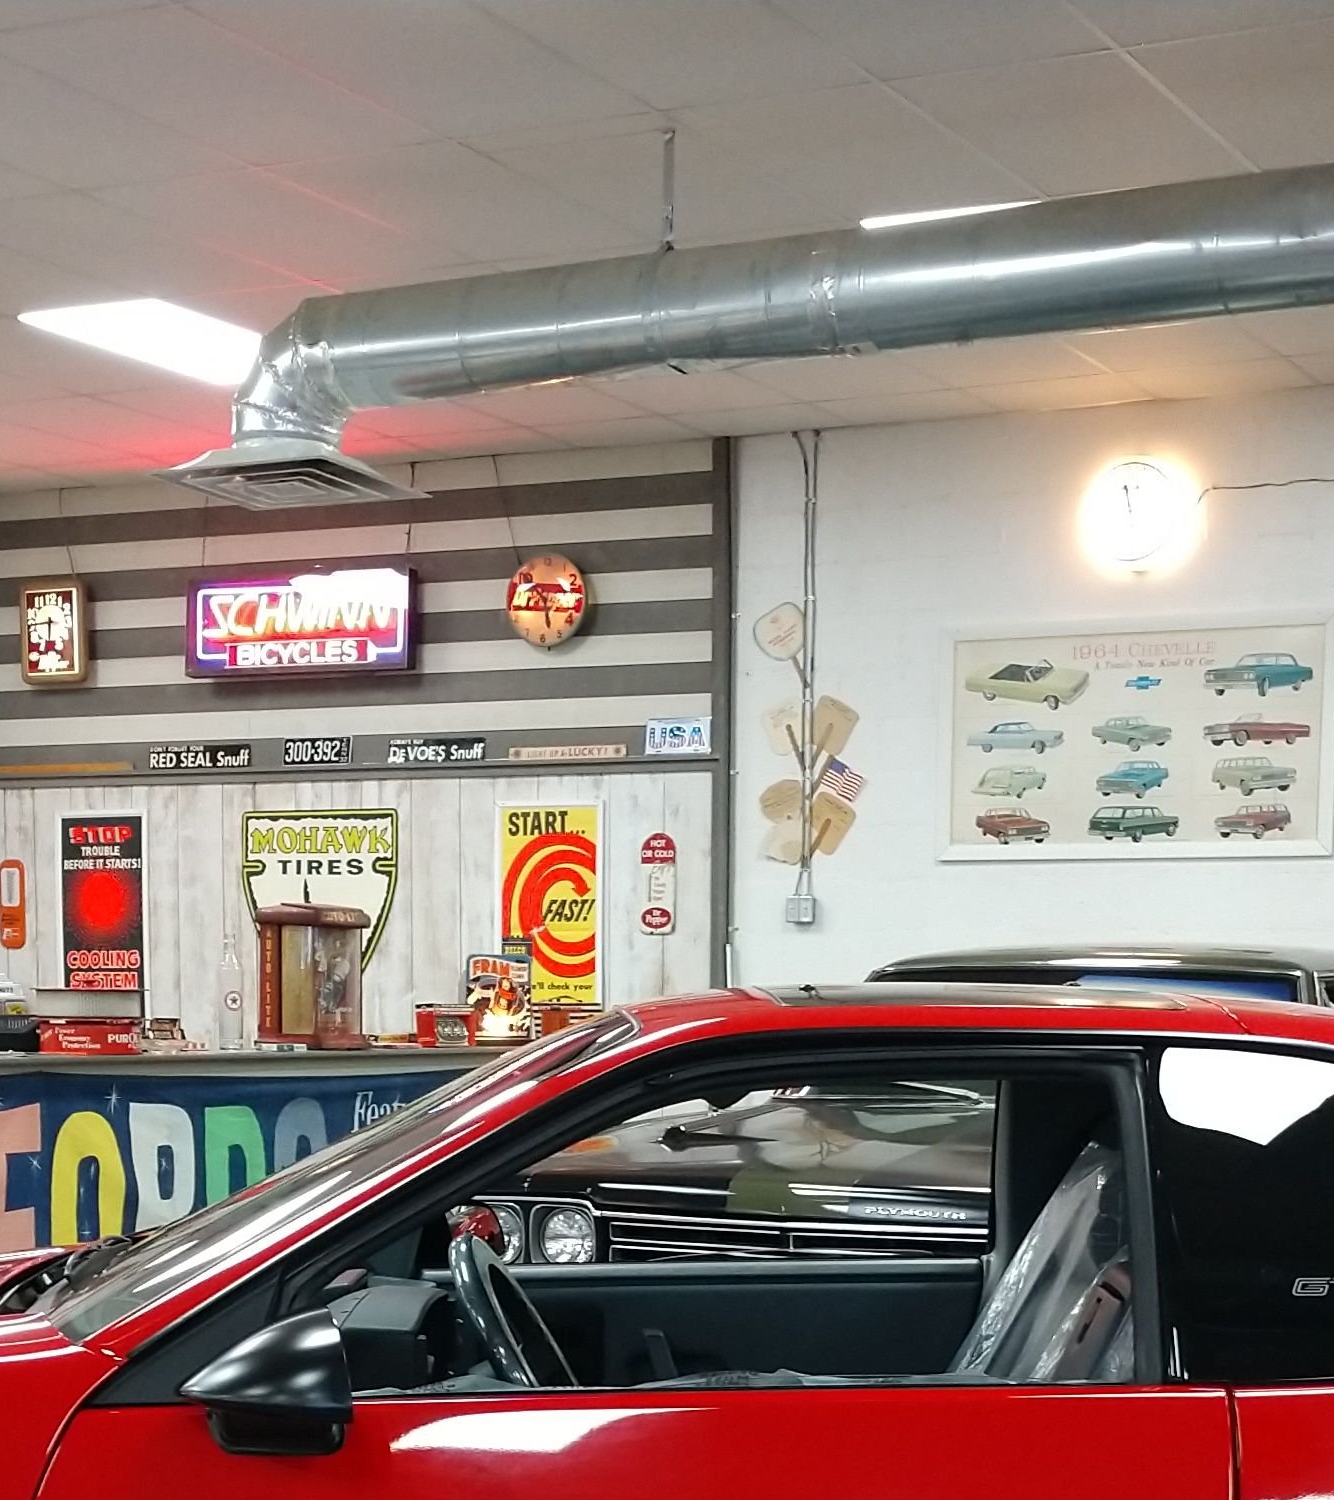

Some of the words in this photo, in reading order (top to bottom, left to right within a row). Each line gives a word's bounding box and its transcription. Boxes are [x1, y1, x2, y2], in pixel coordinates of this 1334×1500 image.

[236, 640, 359, 666] BICYCLES
[1072, 643, 1119, 660] 1964
[1128, 640, 1216, 658] CHEVELLE
[649, 725, 706, 749] USA
[149, 752, 177, 768] RED
[180, 751, 213, 768] SEAL
[216, 749, 250, 767] Snuff
[449, 742, 485, 761] Snuff
[68, 825, 133, 845] STOP
[249, 825, 391, 855] MOHAWK
[650, 839, 667, 848] HOT
[80, 845, 121, 857] TROUBLE
[642, 850, 653, 858] OR
[654, 850, 674, 858] COLD
[63, 859, 95, 871] BEFORE
[96, 859, 104, 869] IT
[105, 858, 142, 869] STARTS!
[277, 858, 364, 876] TIRES
[543, 898, 596, 922] FAST!
[67, 949, 141, 969] COOLING
[472, 957, 511, 978] FRAM
[69, 971, 139, 990] SYSTEM
[547, 982, 570, 991] check
[574, 984, 593, 993] your
[864, 1206, 967, 1220] PLYMOUTH
